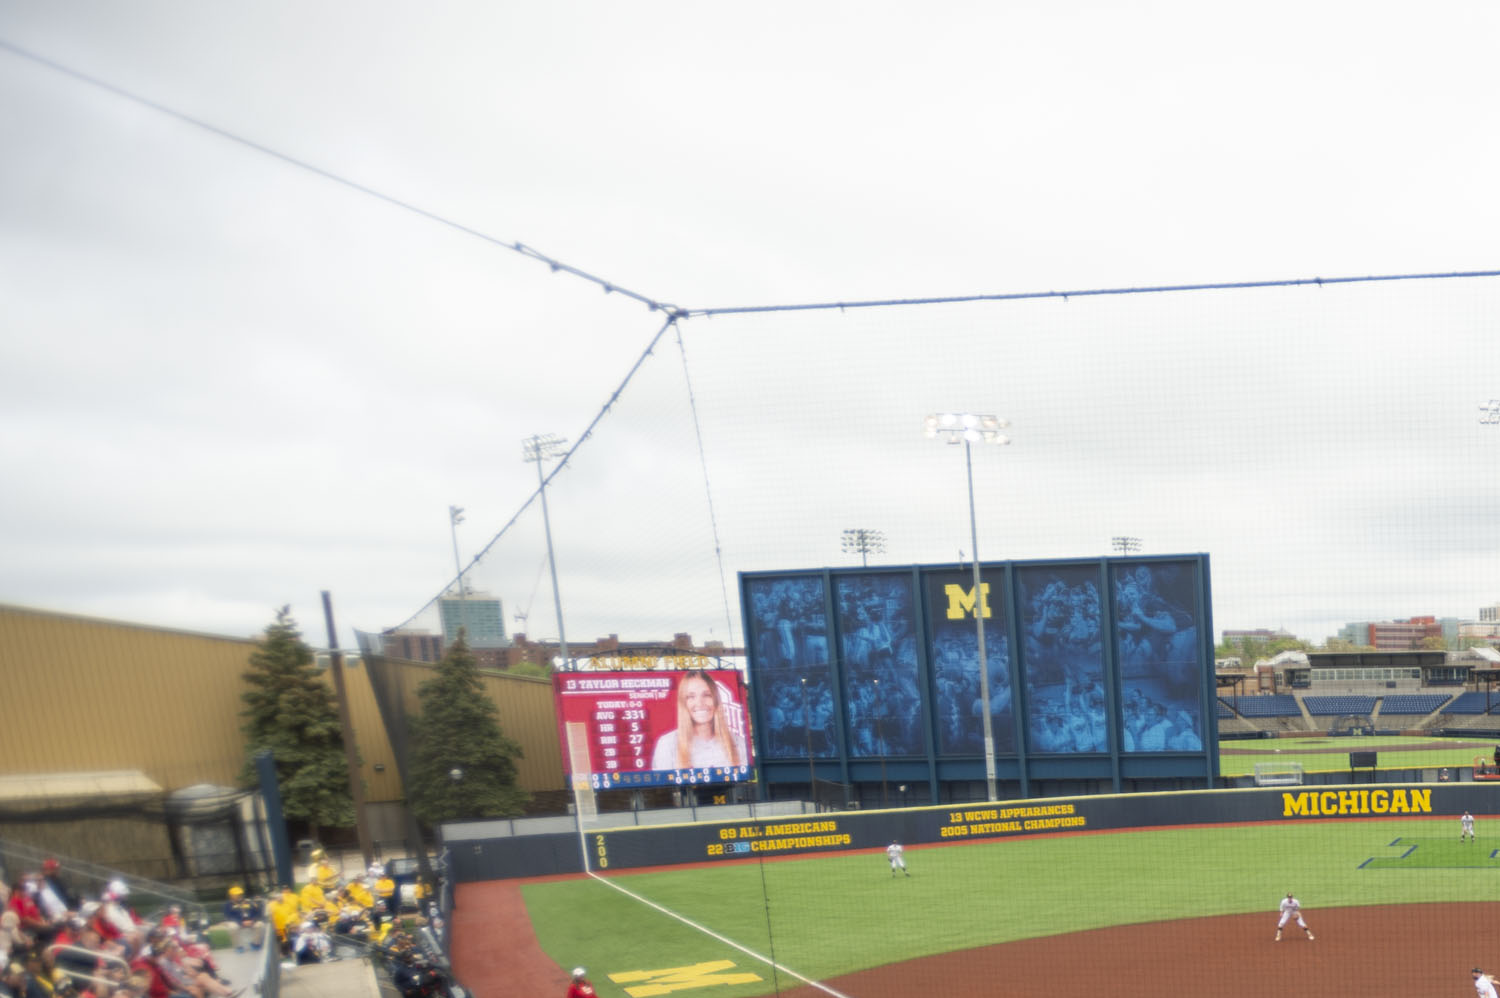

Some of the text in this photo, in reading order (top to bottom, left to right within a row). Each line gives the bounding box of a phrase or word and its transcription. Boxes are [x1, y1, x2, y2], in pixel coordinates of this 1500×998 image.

[944, 583, 991, 620] M
[566, 678, 670, 689] 13 TAYLOR HECKMAN
[596, 710, 645, 720] AVG .331
[631, 722, 639, 731] 5
[629, 734, 643, 744] 27
[634, 746, 641, 756] 7
[636, 759, 644, 768] 0
[713, 795, 727, 804] M
[1282, 789, 1432, 817] MICHIGAN
[950, 804, 1075, 822] 13 WCWS APPEARANCES
[719, 828, 737, 840] 69
[765, 821, 836, 836] AMERICANS
[941, 816, 1086, 837] 2005 NATIONAL CHAMPIONS
[707, 844, 723, 855] 22
[751, 834, 851, 852] CHAMPIONSHIPS
